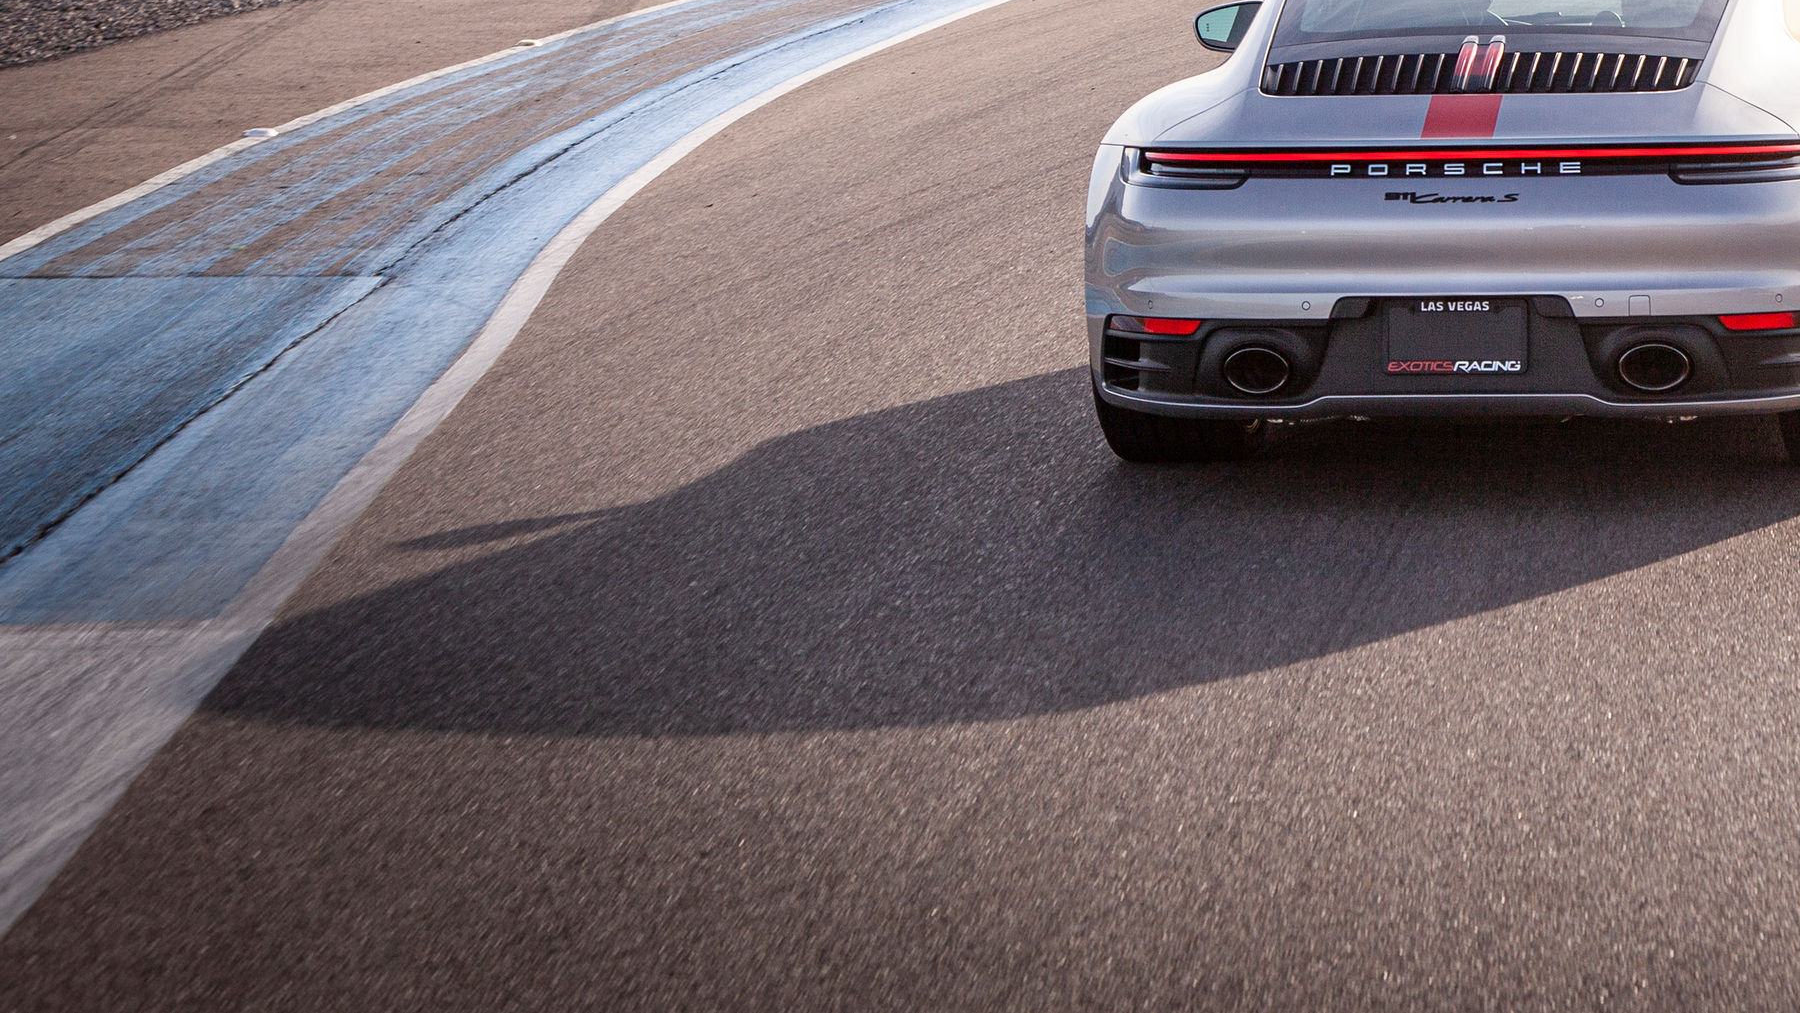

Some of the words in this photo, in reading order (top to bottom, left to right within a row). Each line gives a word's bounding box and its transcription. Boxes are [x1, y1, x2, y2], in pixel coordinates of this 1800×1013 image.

[1330, 162, 1581, 176] PORSCHE
[1411, 193, 1496, 204] Carrera
[1497, 193, 1519, 203] S
[1421, 301, 1444, 312] LAS
[1447, 301, 1490, 311] VEGAS
